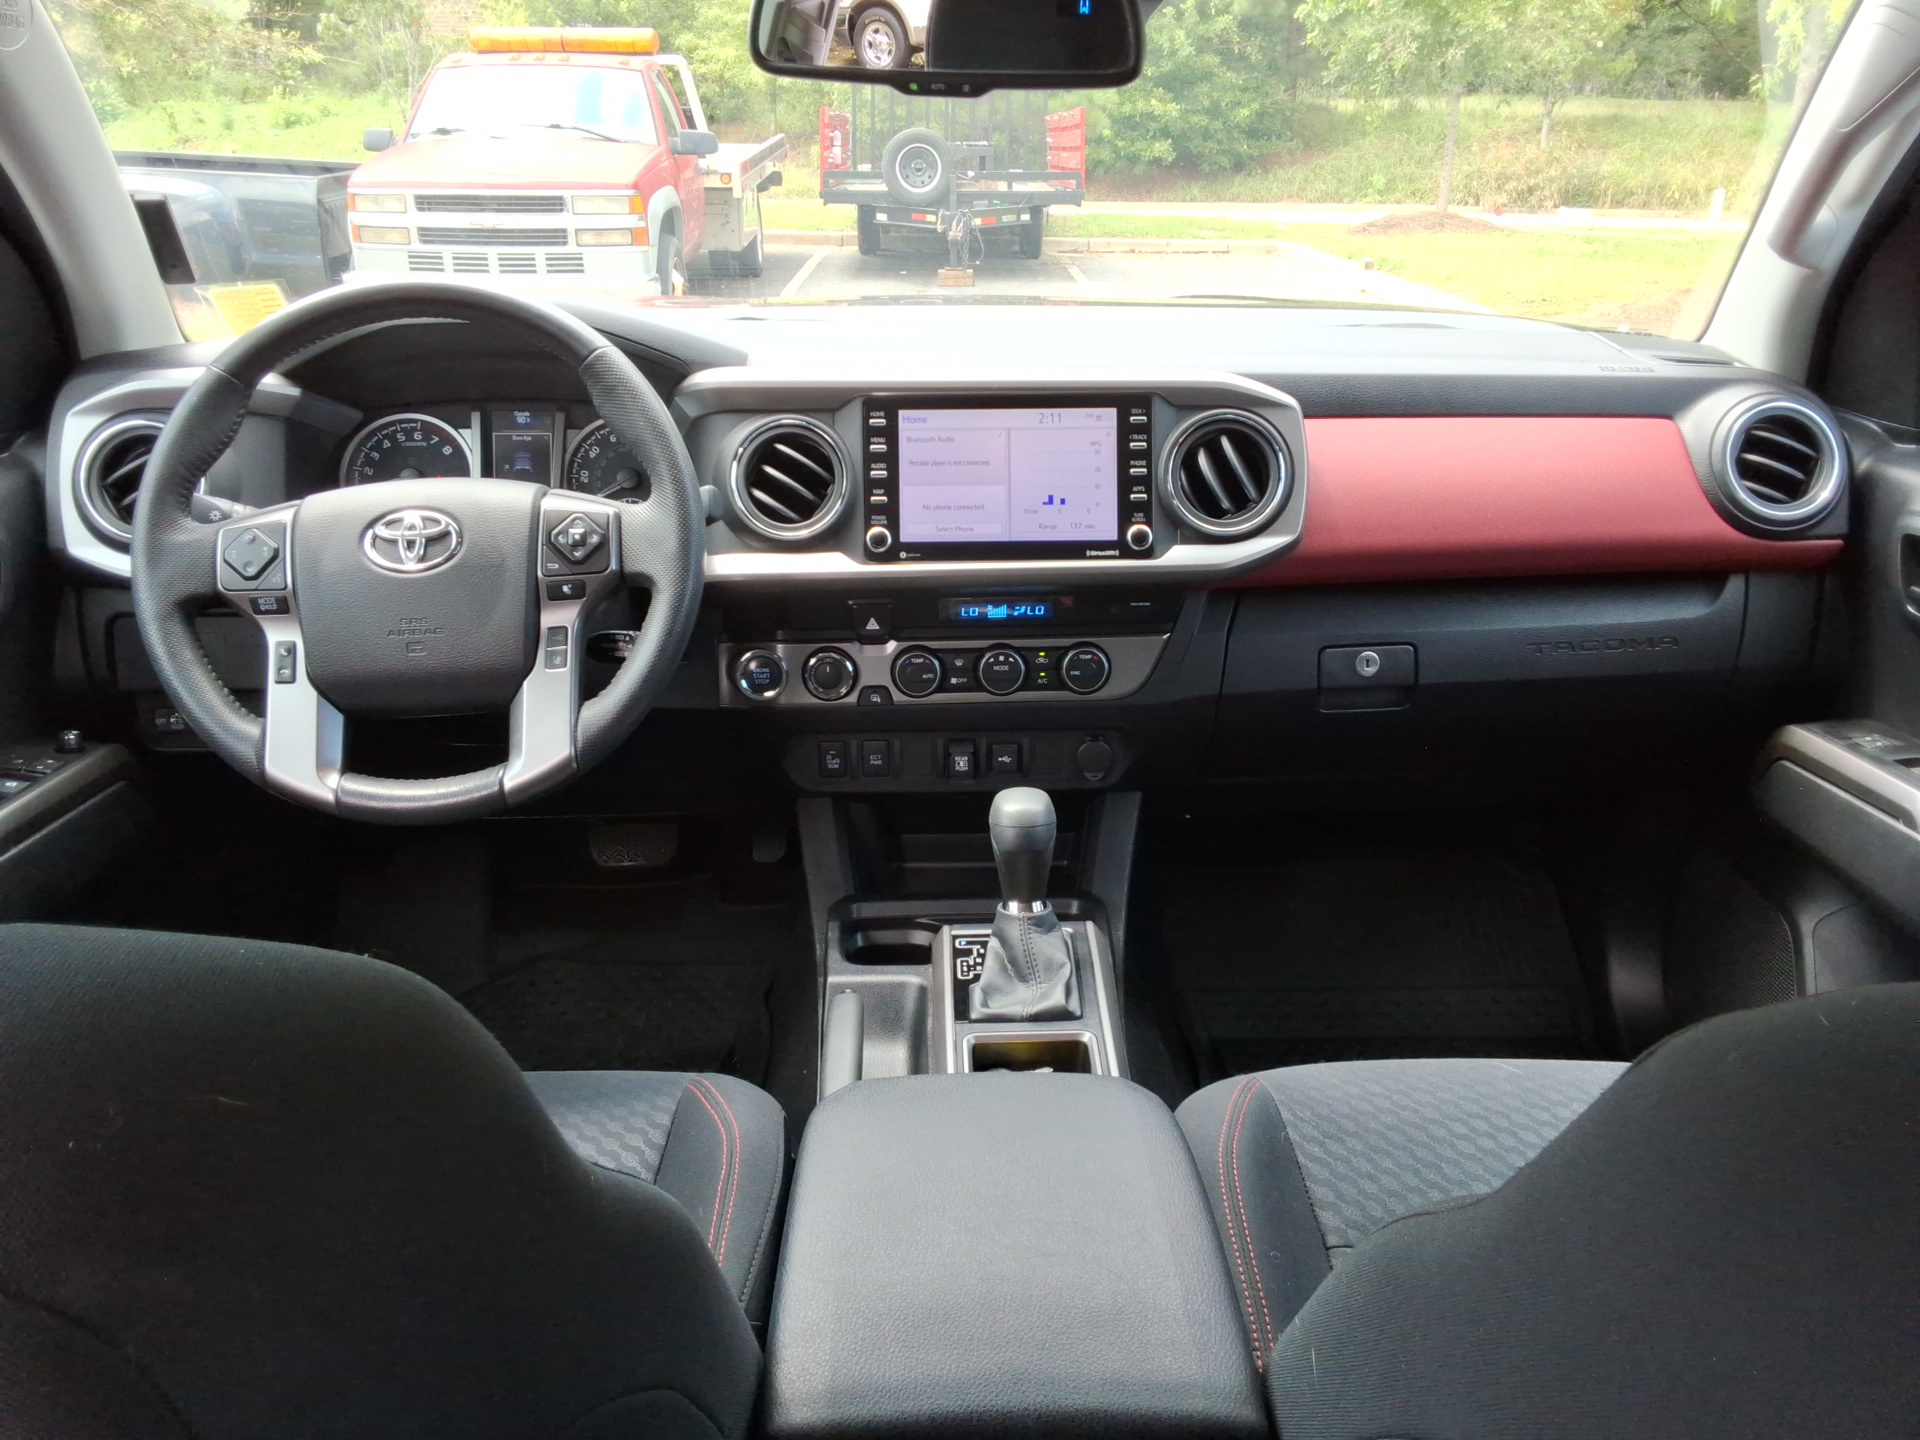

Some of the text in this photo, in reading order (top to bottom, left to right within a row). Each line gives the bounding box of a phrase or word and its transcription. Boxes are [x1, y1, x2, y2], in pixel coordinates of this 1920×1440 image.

[902, 415, 928, 424] Home
[1038, 412, 1062, 424] 2:11
[396, 432, 406, 442] 5
[413, 431, 423, 440] 6
[430, 435, 440, 444] 7
[382, 439, 392, 449] 4
[442, 445, 453, 455] 8
[588, 446, 600, 459] 40
[370, 451, 380, 461] 3
[931, 460, 947, 468] player
[579, 470, 589, 483] 20
[933, 504, 952, 512] phone
[935, 525, 975, 533] Select Phone
[1038, 523, 1058, 531] Range
[961, 607, 979, 617] LO
[1027, 605, 1045, 615] LO
[400, 618, 429, 627] SRS
[387, 628, 444, 638] AIRBAG
[1526, 635, 1679, 656] TACOMA
